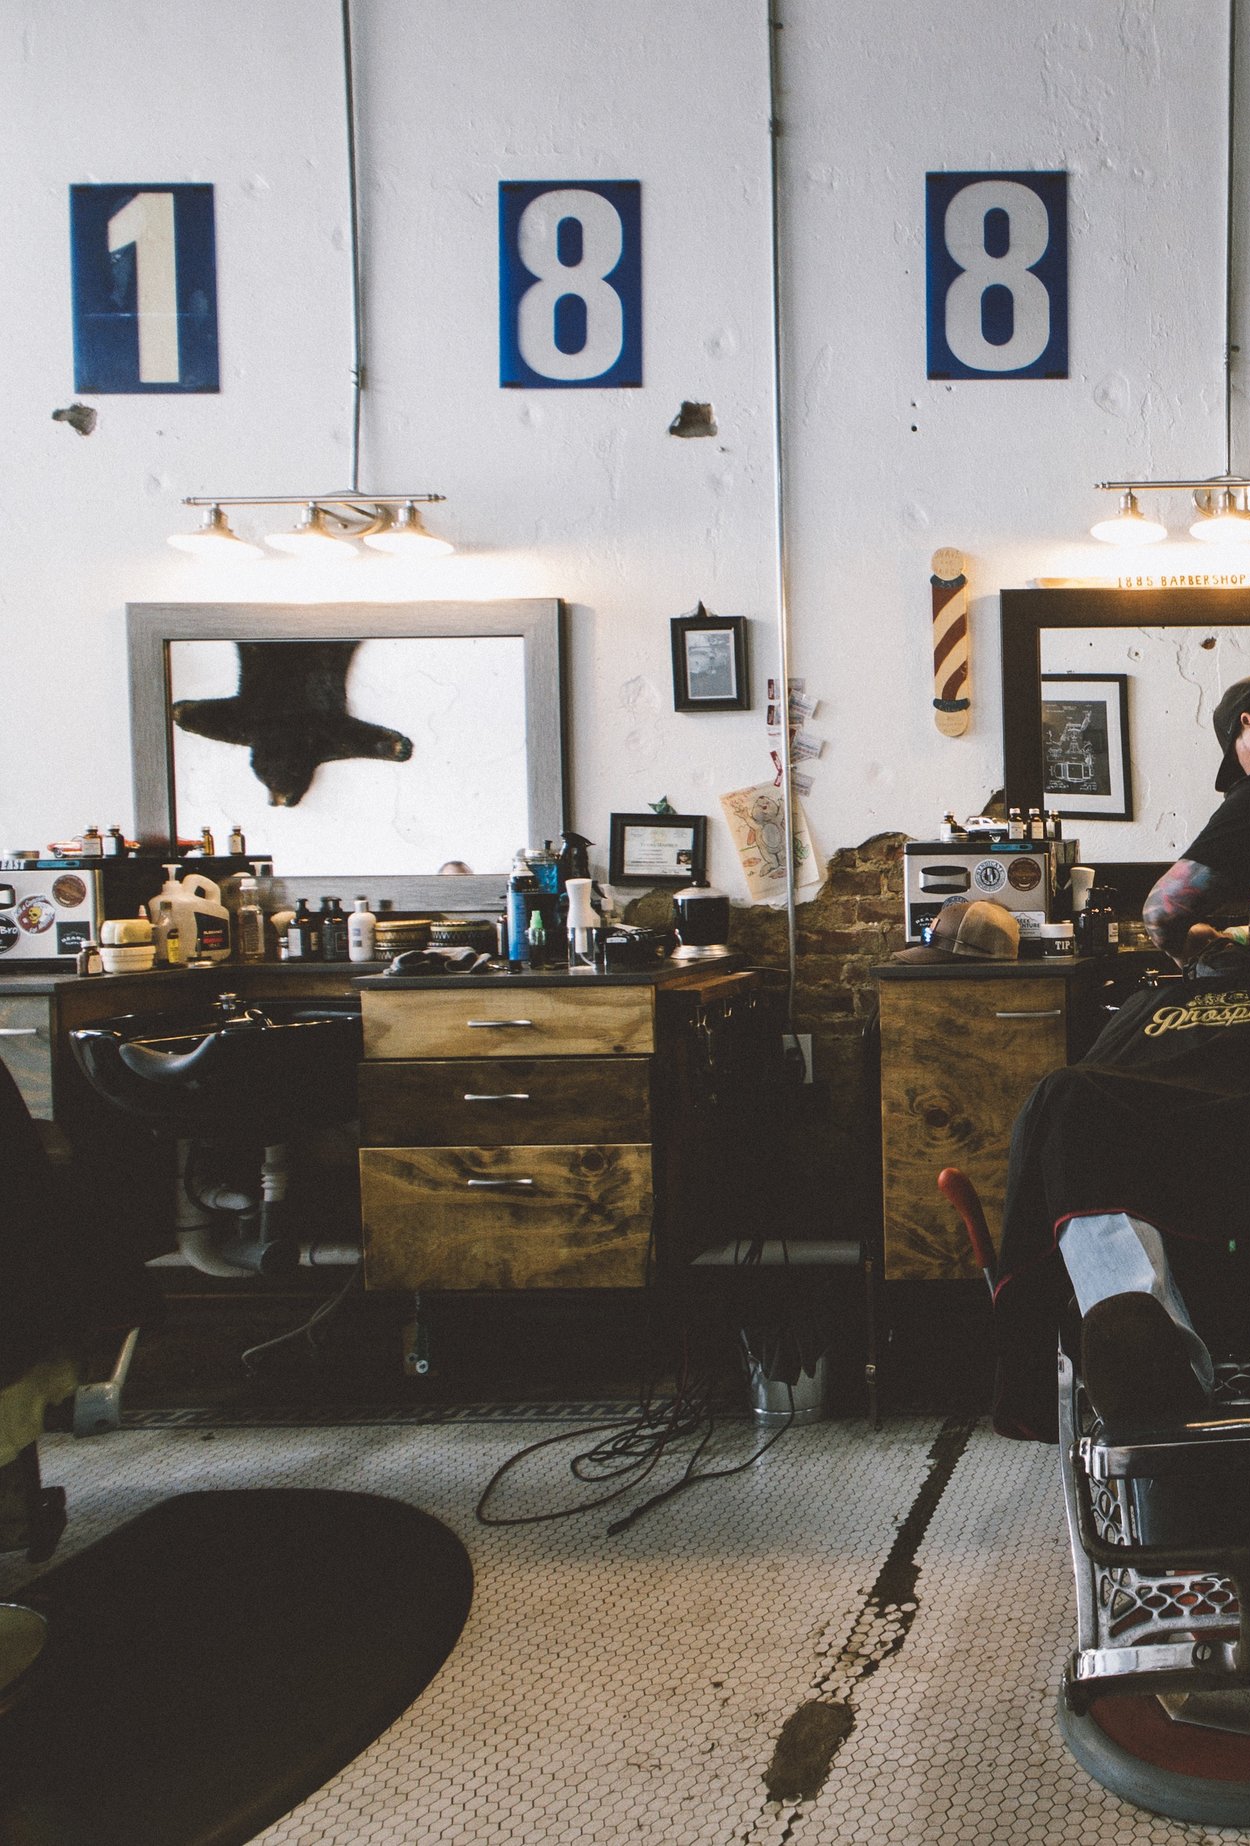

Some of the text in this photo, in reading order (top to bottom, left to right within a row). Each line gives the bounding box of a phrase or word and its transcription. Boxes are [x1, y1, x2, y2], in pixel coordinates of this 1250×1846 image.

[107, 192, 180, 384] 1
[517, 189, 624, 381] 8
[944, 180, 1050, 372] 8
[1118, 574, 1246, 589] 1885 BARBERSHOP
[1055, 940, 1071, 950] TIP
